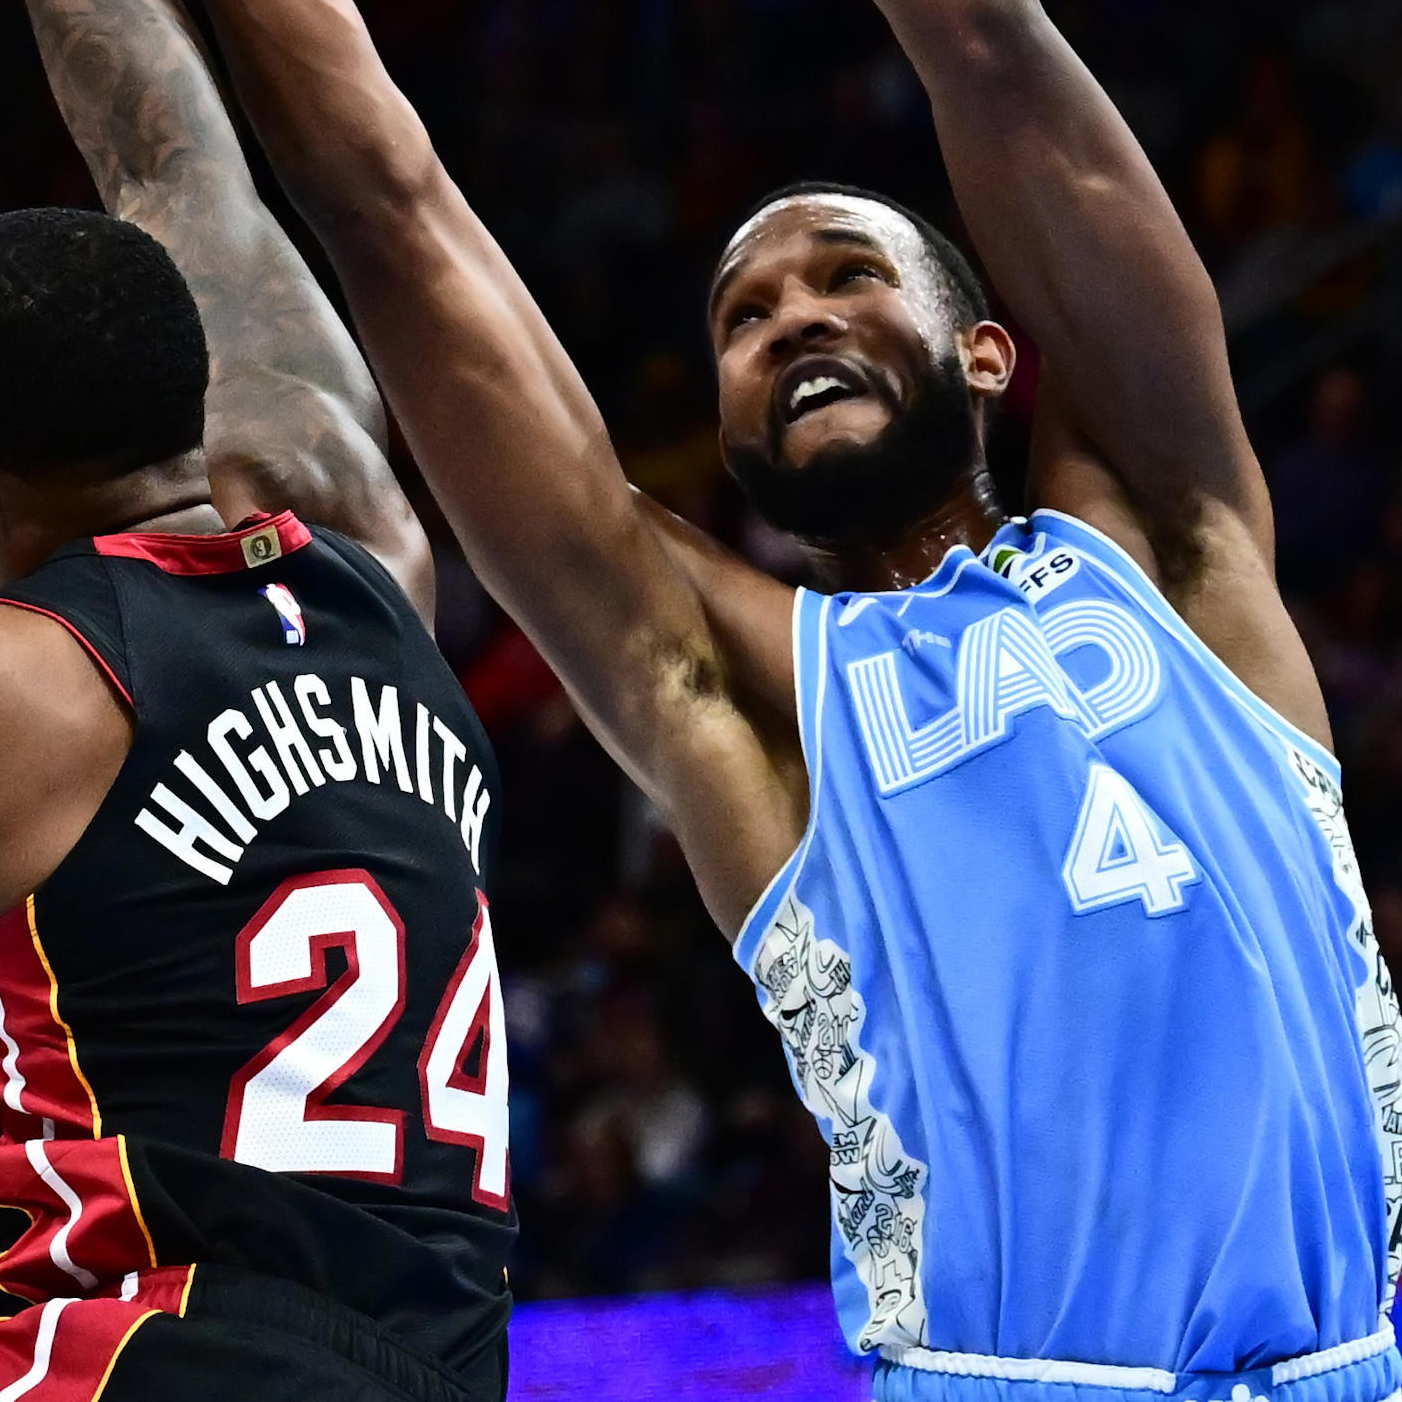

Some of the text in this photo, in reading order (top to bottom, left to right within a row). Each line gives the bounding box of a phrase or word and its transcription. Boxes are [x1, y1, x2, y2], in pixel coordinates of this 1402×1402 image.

[134, 674, 491, 886] HIGHSMITH
[1062, 762, 1200, 918] 4
[219, 867, 509, 1213] 24
